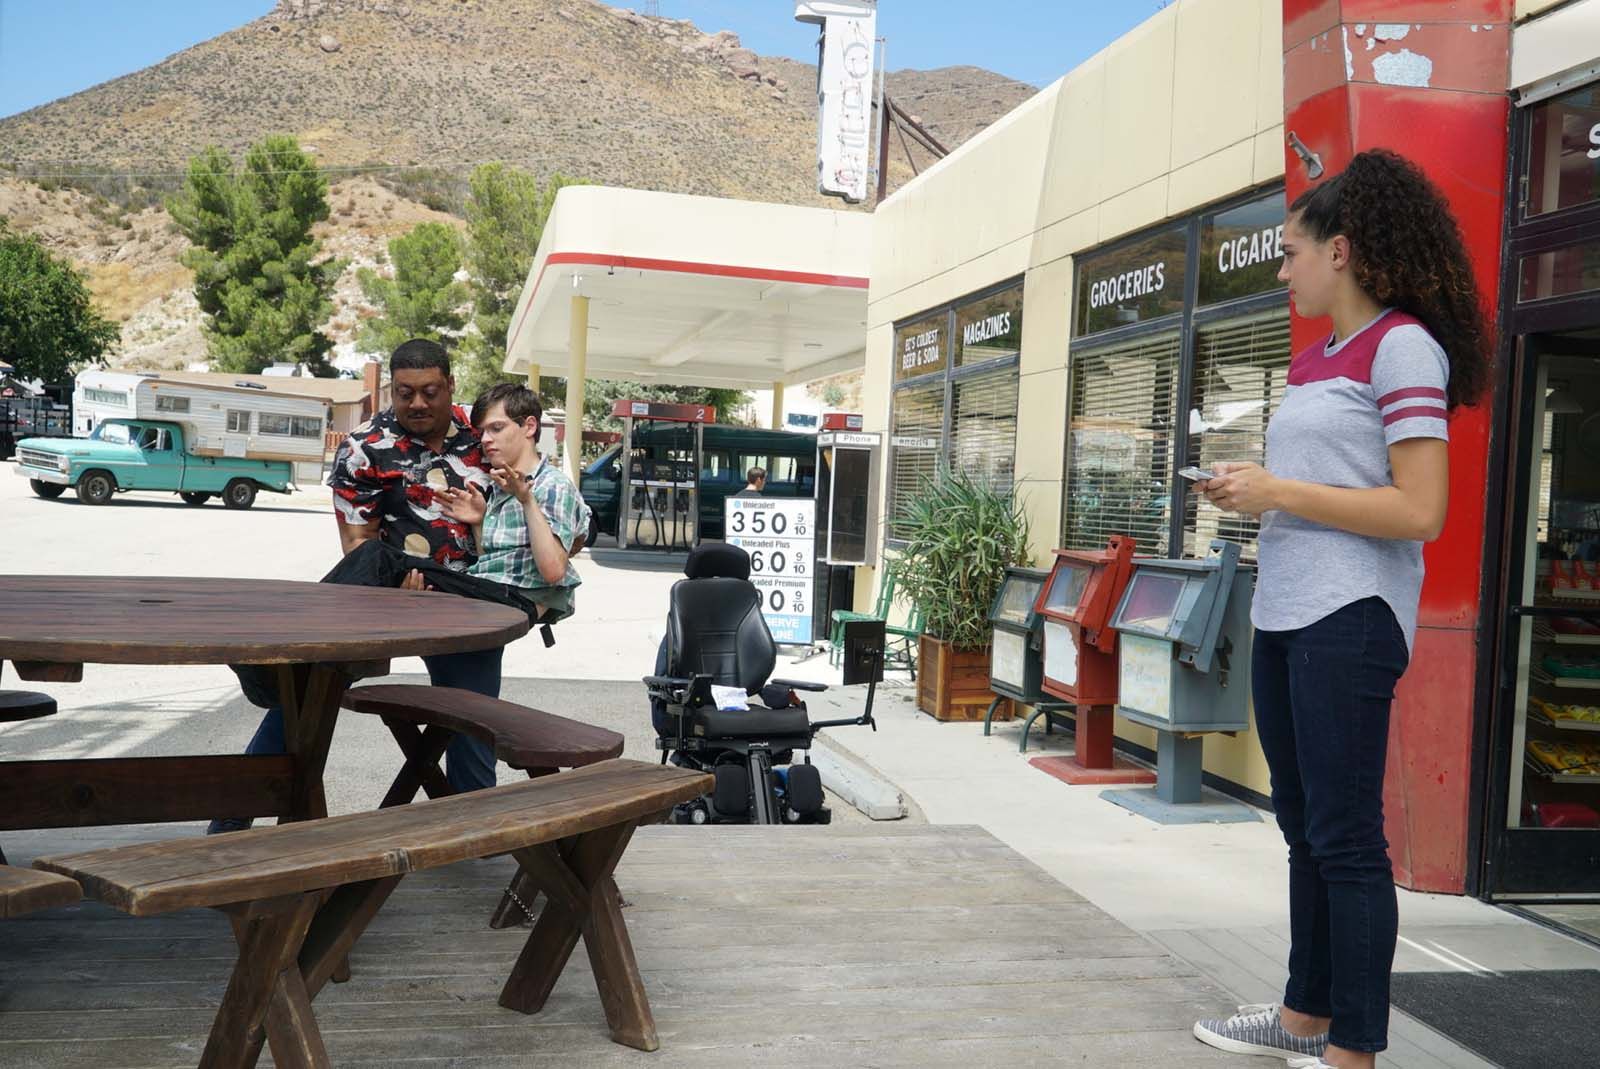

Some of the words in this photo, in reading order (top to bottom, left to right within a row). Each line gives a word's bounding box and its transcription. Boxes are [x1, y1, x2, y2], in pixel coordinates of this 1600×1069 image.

[1218, 224, 1284, 273] CIGARE
[1091, 262, 1164, 308] GROCERIES
[963, 312, 1011, 346] MAGAZINES
[902, 353, 916, 370] BEER
[923, 345, 939, 364] SODA
[696, 408, 705, 420] 2
[843, 434, 872, 443] Phone
[743, 501, 775, 509] Unleaded
[732, 511, 787, 534] 350
[741, 539, 774, 549] Unleaded
[775, 540, 791, 549] Plus
[750, 550, 786, 573] 60
[774, 579, 806, 588] Premium
